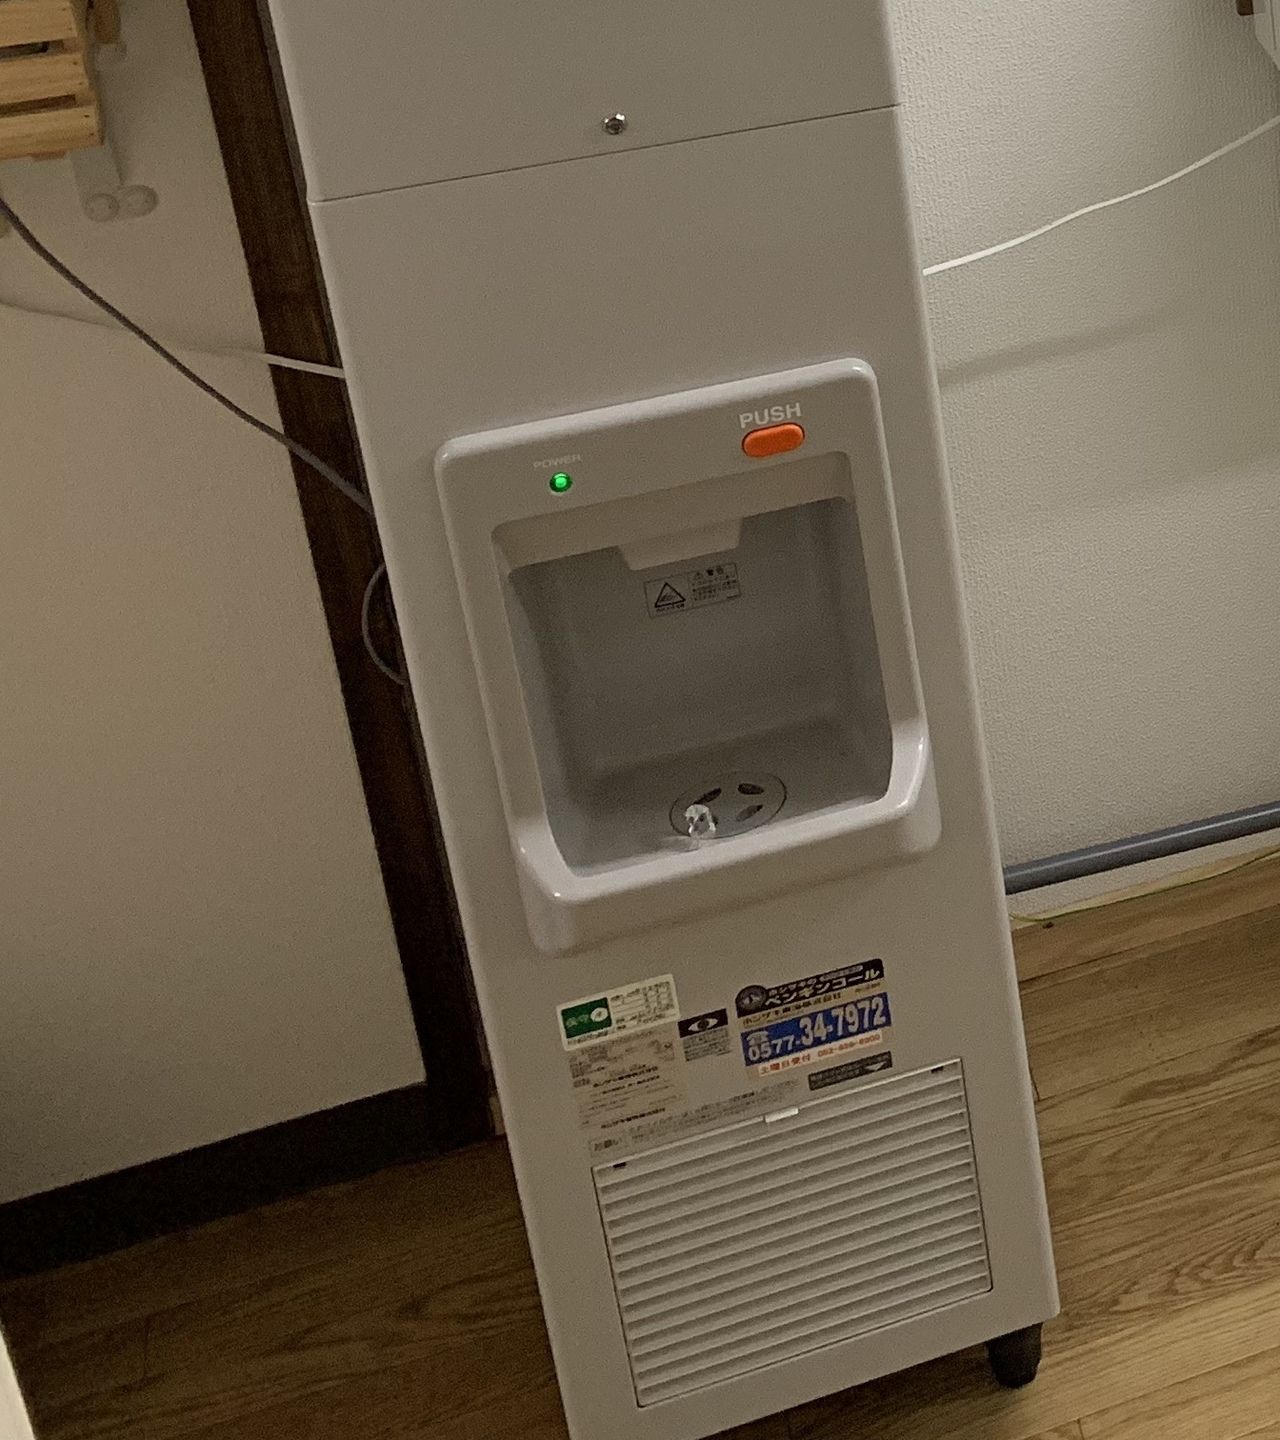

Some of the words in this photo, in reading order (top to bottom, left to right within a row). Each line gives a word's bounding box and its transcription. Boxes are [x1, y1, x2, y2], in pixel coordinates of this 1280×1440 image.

[738, 403, 802, 428] PUSH
[533, 453, 584, 470] POWER
[764, 967, 881, 1006] ペンギンコール
[748, 996, 887, 1061] 0577-34-7972
